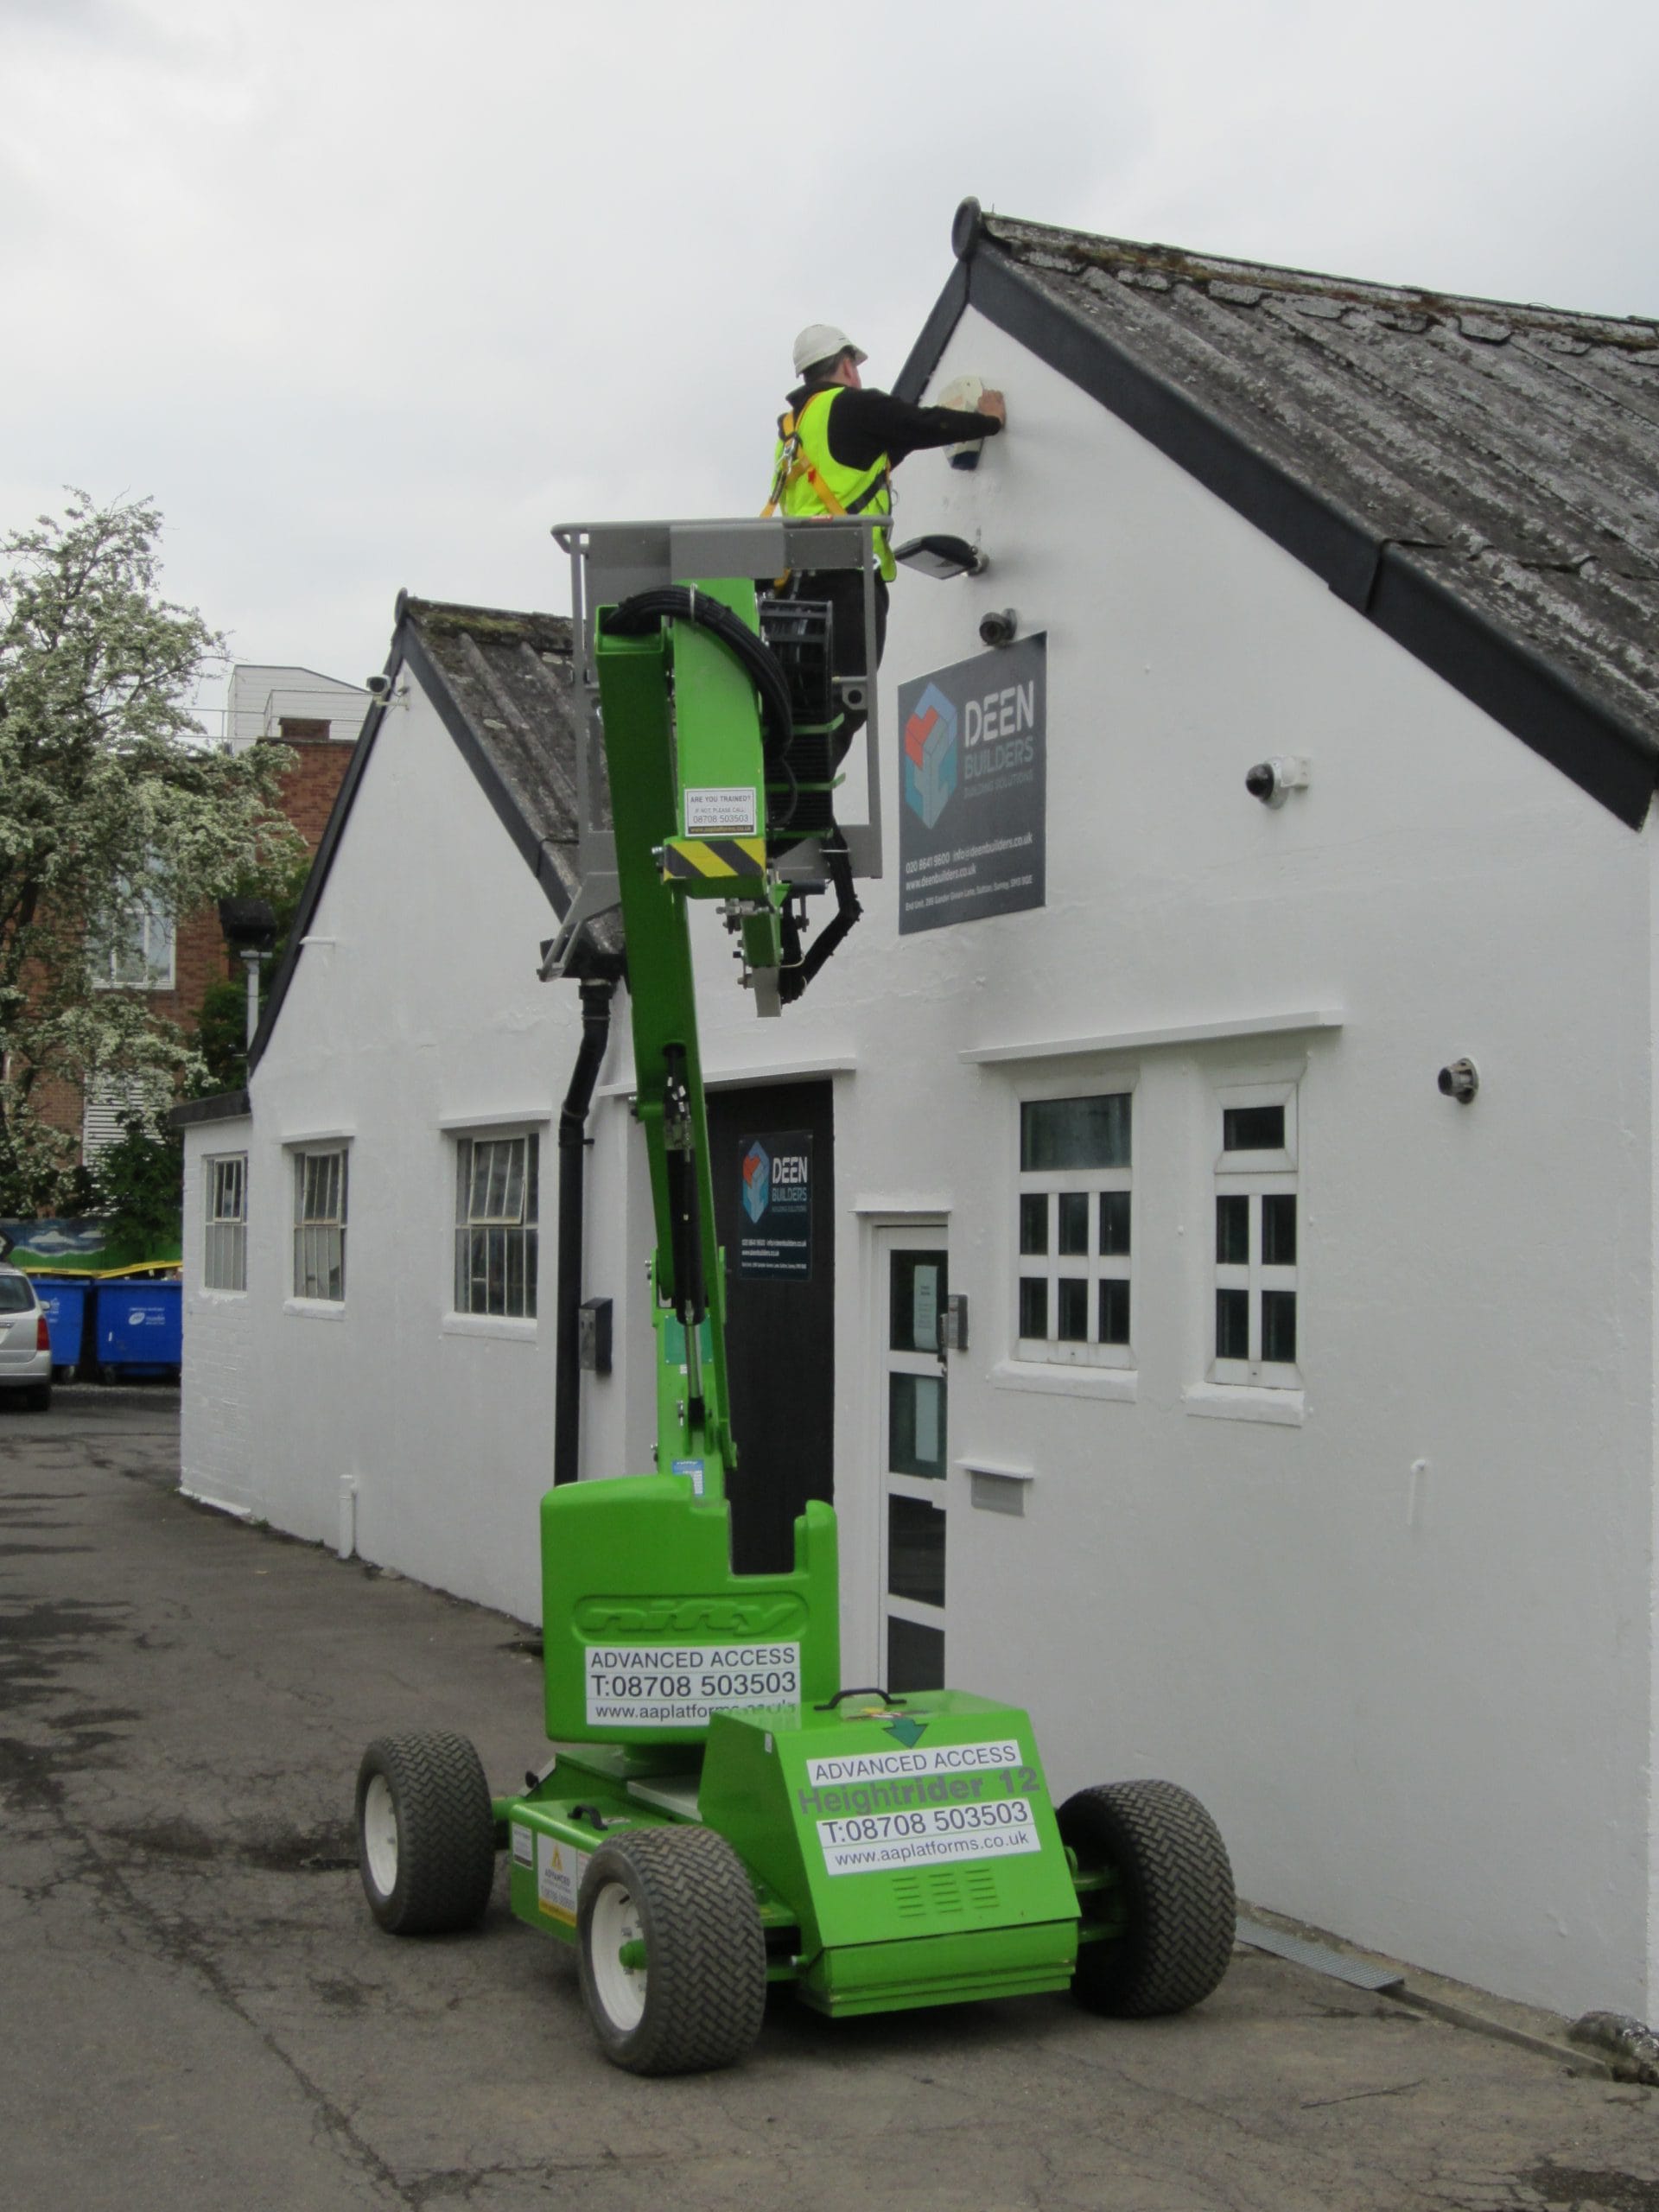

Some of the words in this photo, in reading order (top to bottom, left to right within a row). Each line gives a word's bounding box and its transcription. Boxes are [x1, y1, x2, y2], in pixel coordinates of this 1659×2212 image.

[965, 680, 1034, 747] DEEN
[964, 735, 1033, 779] BUILDERS
[693, 815, 717, 823] 08708
[720, 814, 748, 823] 503503
[906, 861, 918, 874] 020
[906, 863, 976, 891] www.deenbuilders.co.uk
[772, 1156, 808, 1184] DEEN
[772, 1187, 807, 1202] BUILDERS
[591, 1651, 703, 1669] ADVANCED
[710, 1647, 795, 1668] ACCESS
[591, 1675, 691, 1697] T:08708
[701, 1671, 796, 1696] 503503
[815, 1754, 927, 1781] ADVANCED
[934, 1745, 1016, 1770] ACCESS
[798, 1774, 983, 1815] Heightrider
[999, 1767, 1040, 1794] 12
[822, 1815, 926, 1843] T:08708
[934, 1801, 1028, 1832] 503503
[835, 1831, 1029, 1866] www.aaplatforms.co.uk
